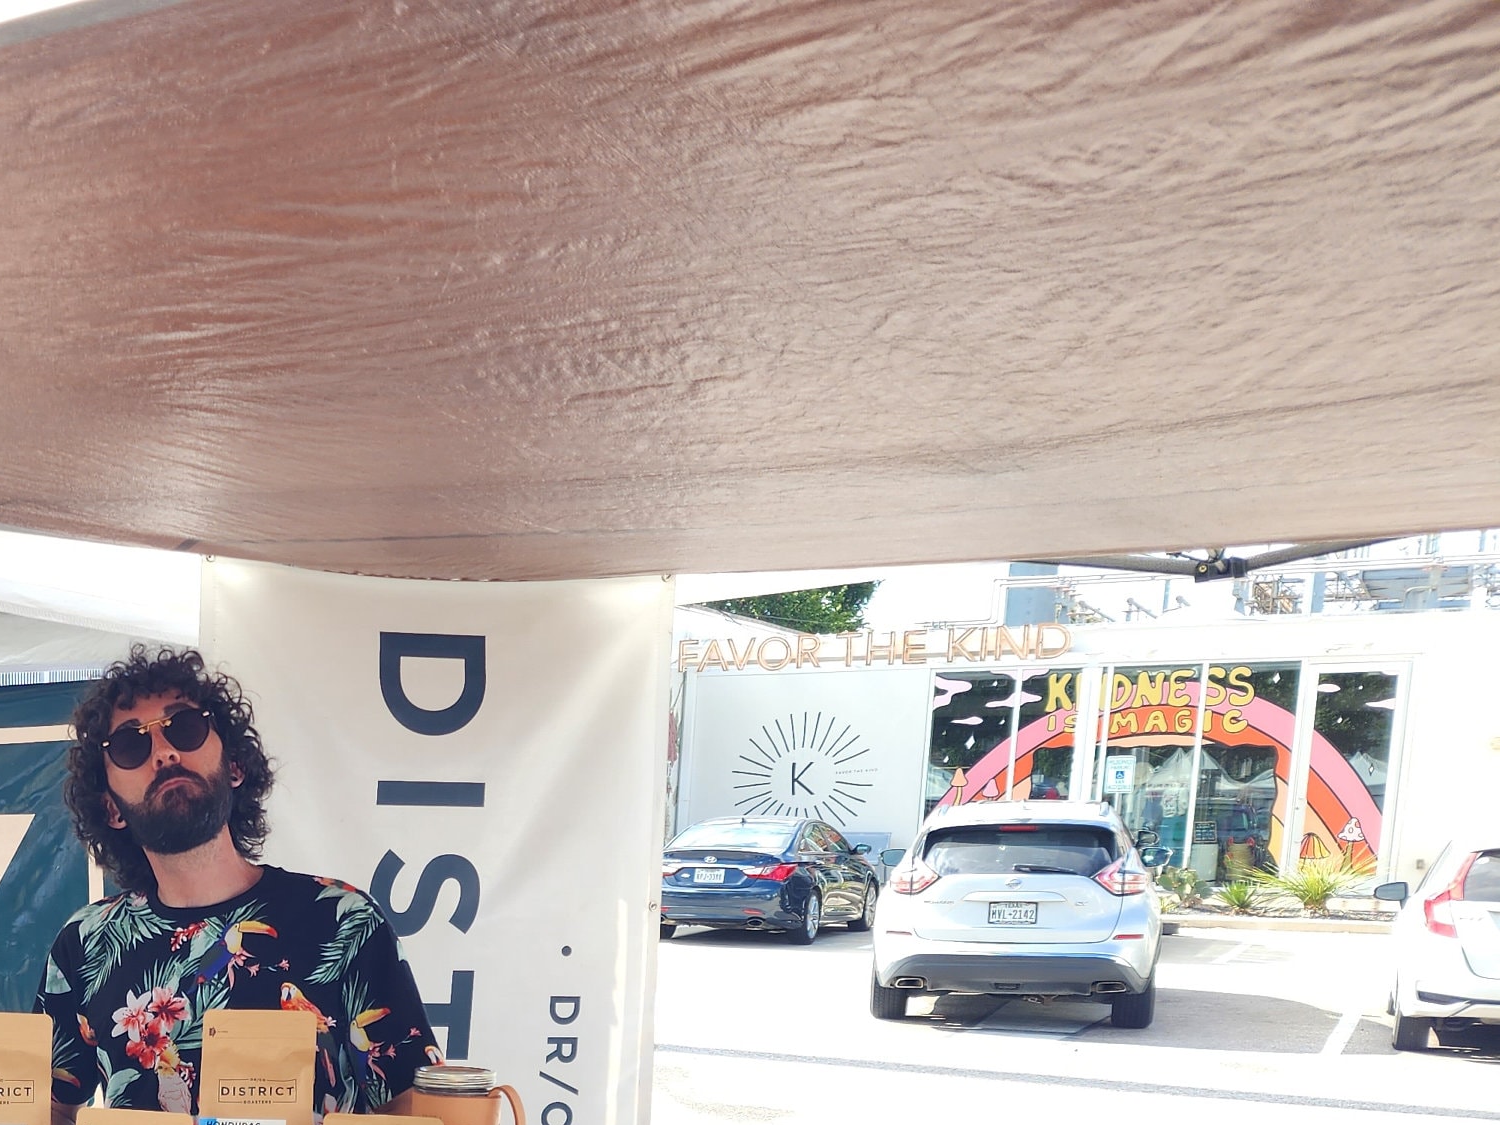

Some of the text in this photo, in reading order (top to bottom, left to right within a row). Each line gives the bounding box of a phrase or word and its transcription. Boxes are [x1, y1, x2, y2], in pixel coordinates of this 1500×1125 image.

[678, 622, 1073, 672] FAVOR THE KIND
[1110, 709, 1248, 734] MAGIC
[791, 762, 815, 796] K
[221, 1086, 294, 1096] DISTRICT
